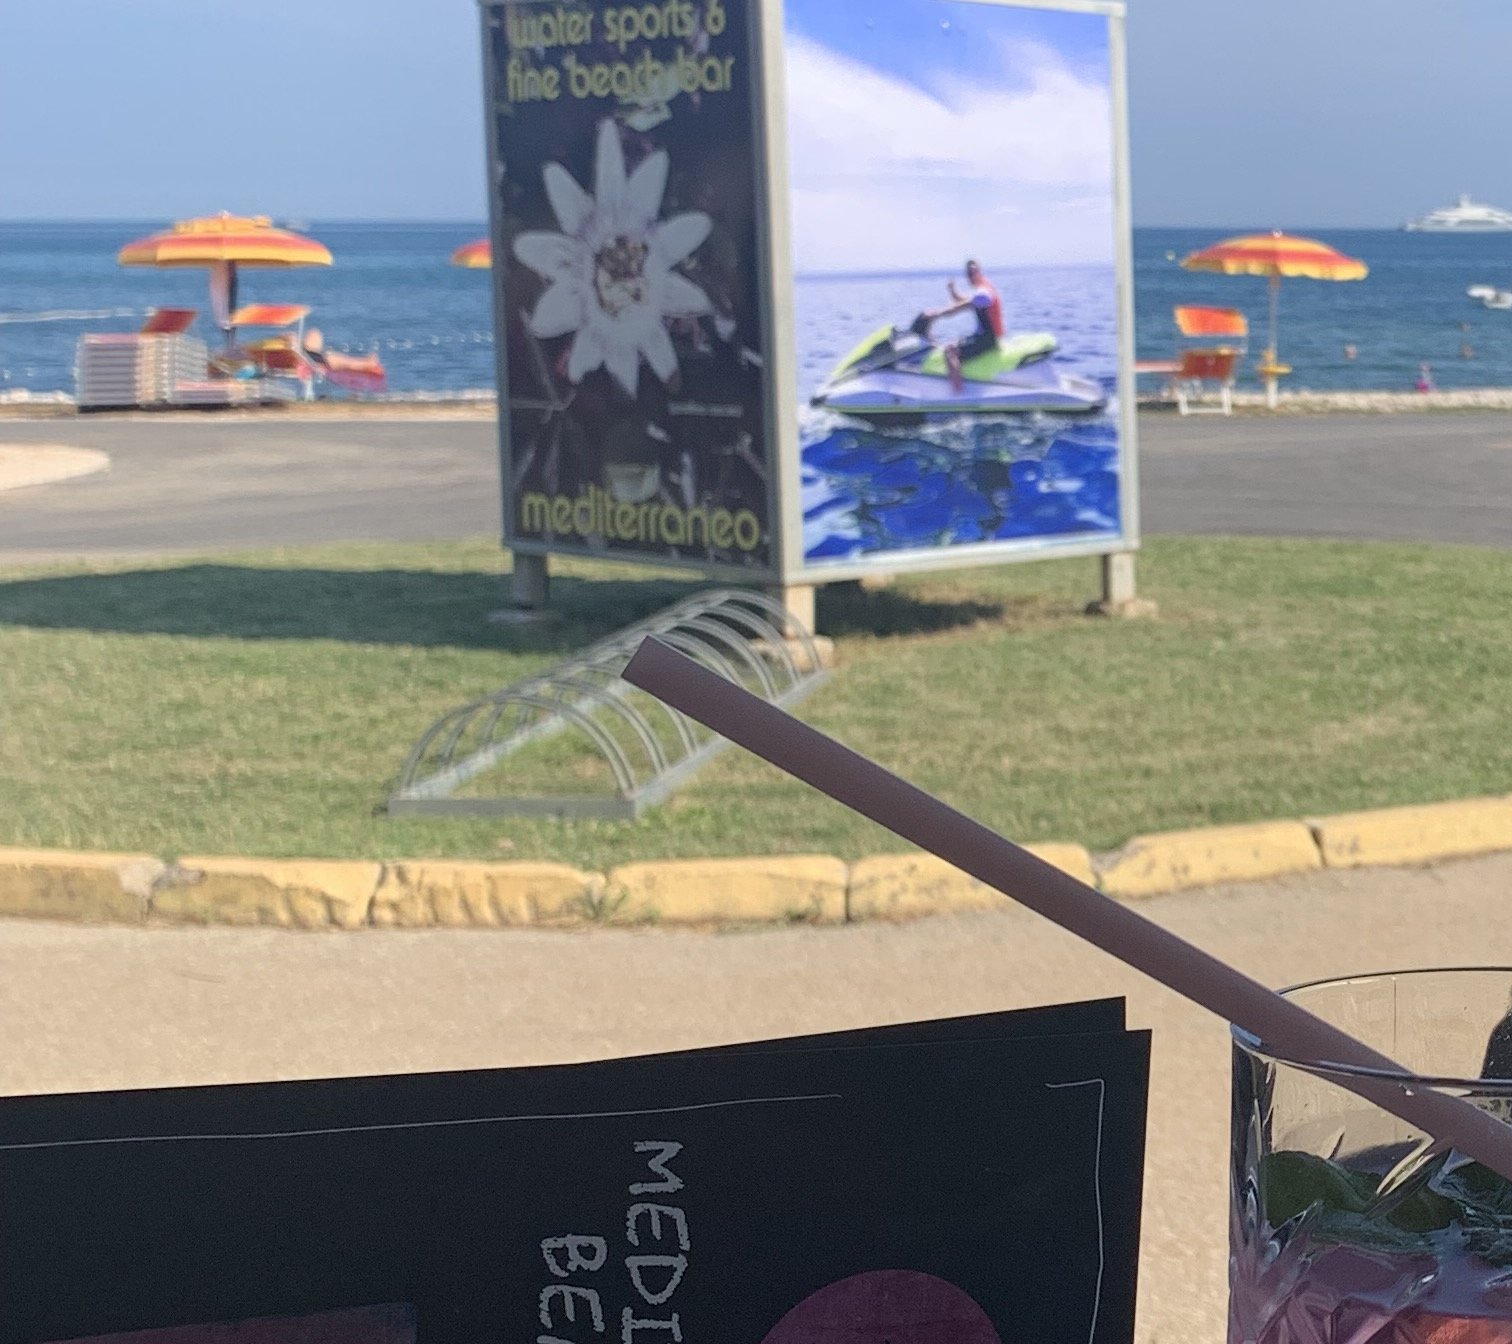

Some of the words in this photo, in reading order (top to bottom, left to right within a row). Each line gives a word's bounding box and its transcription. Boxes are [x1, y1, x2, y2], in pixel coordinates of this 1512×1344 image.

[507, 6, 593, 48] water
[507, 57, 560, 102] fine
[569, 49, 666, 99] beach
[677, 45, 736, 92] bar
[521, 483, 760, 551] mediterraneo
